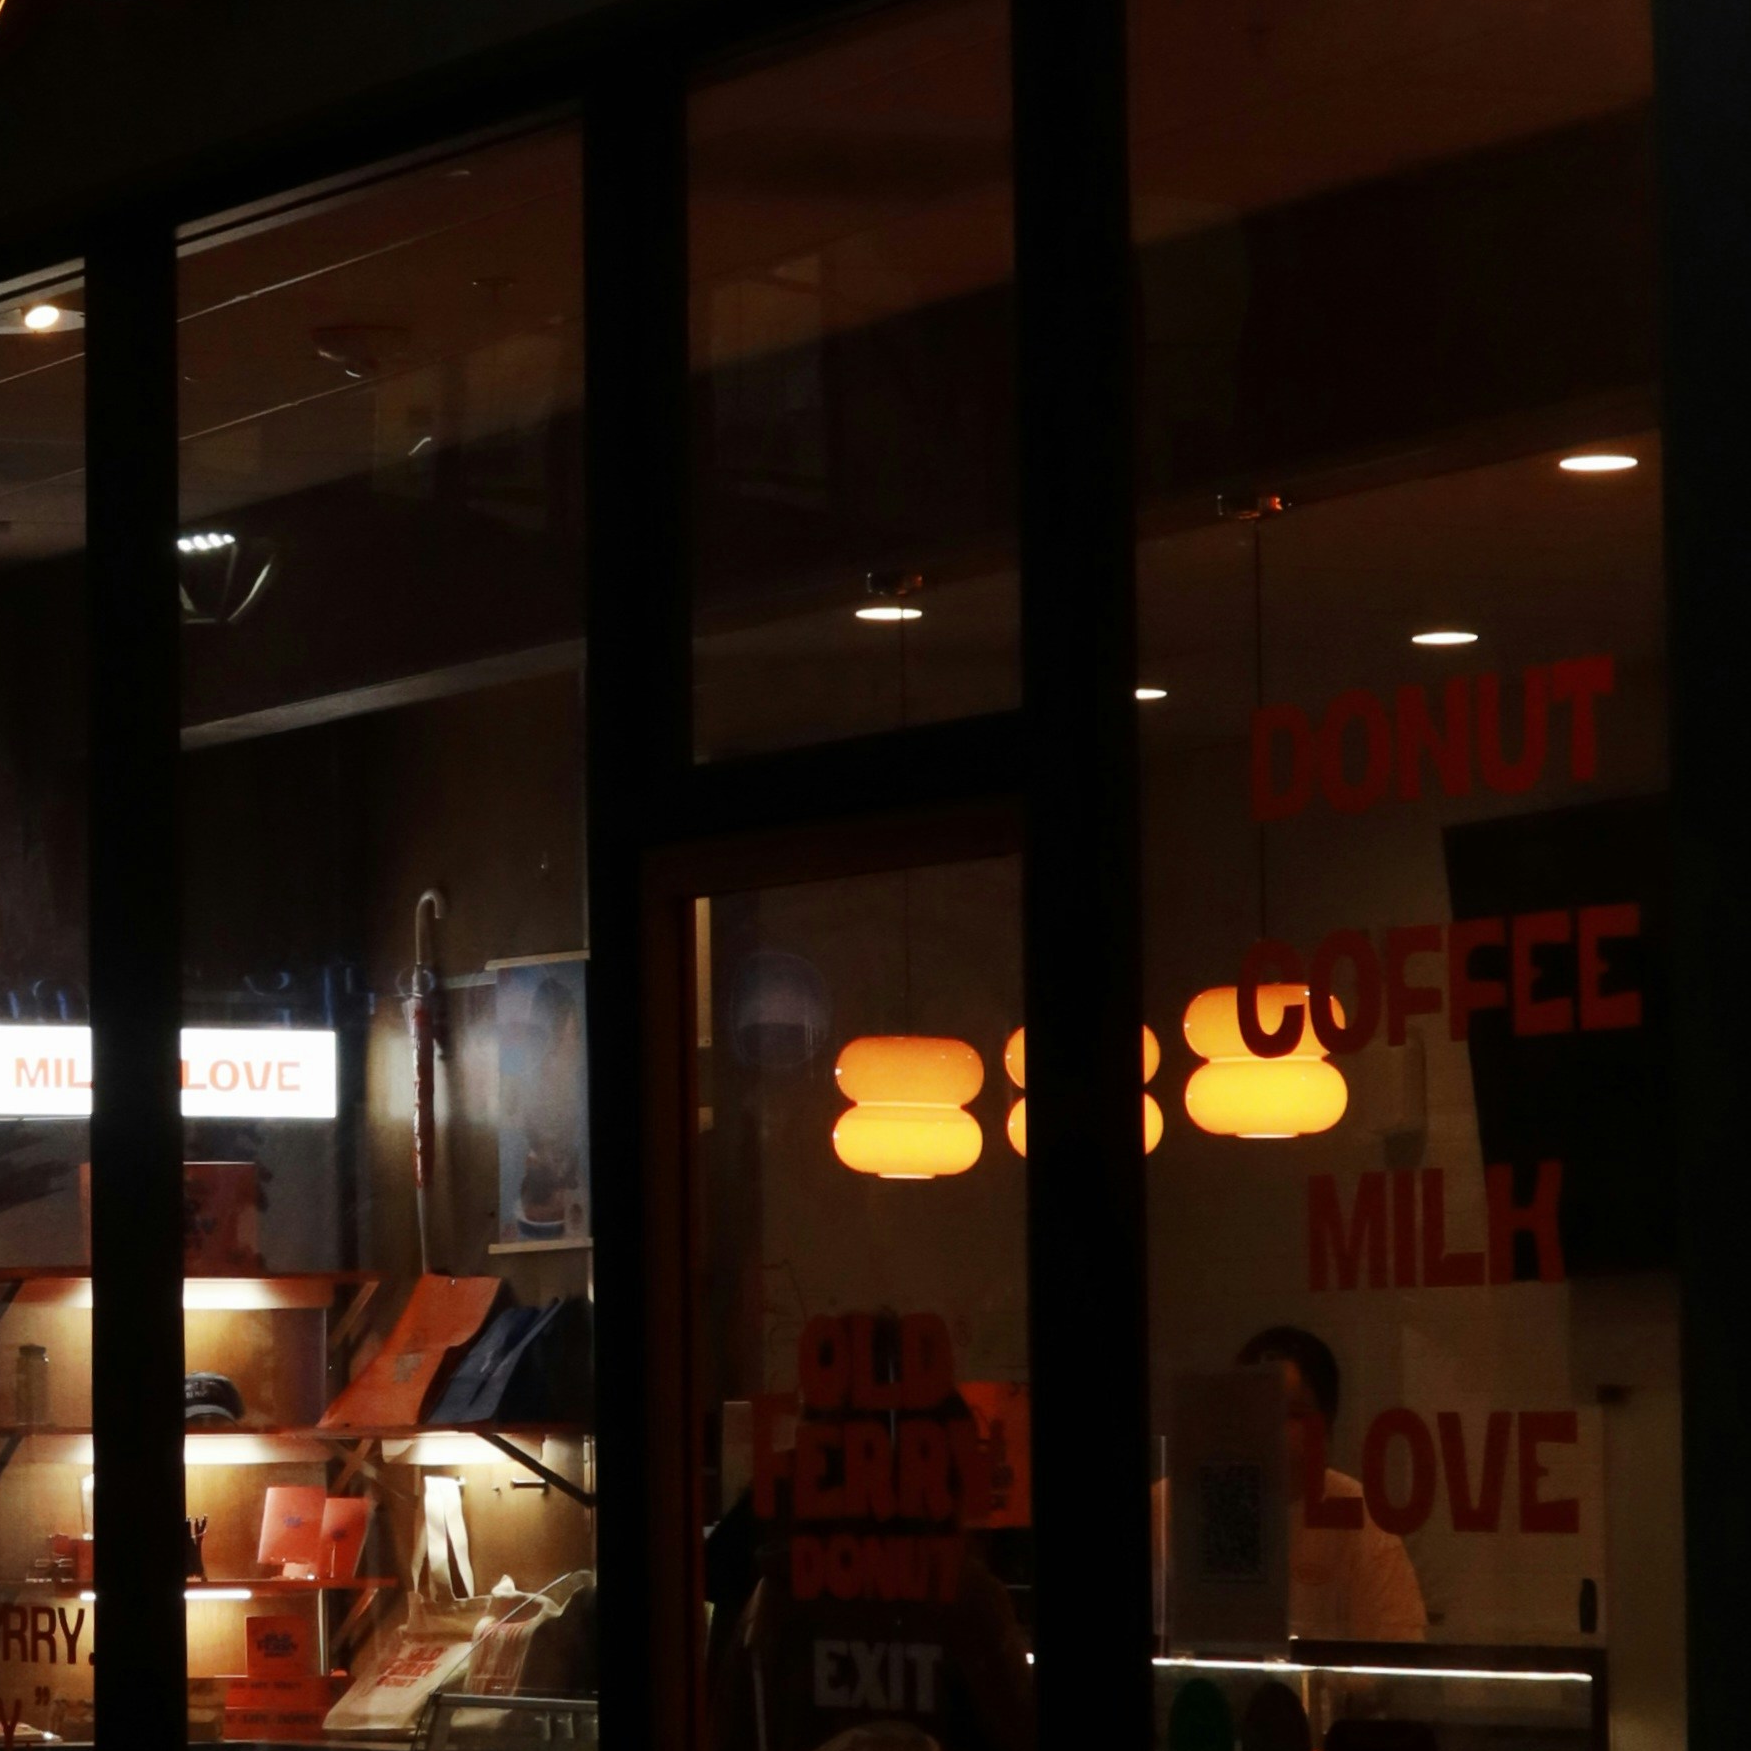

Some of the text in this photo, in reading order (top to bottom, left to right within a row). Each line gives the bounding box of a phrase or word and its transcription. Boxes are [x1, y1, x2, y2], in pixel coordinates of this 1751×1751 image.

[1249, 653, 1614, 822] DONUT
[1236, 903, 1643, 1059] COFFEE
[14, 1057, 93, 1090] MIL
[180, 1059, 302, 1093] LOVE
[799, 1312, 955, 1412] OLD
[1302, 1407, 1580, 1536] LOVE
[812, 1638, 945, 1713] EXIT
